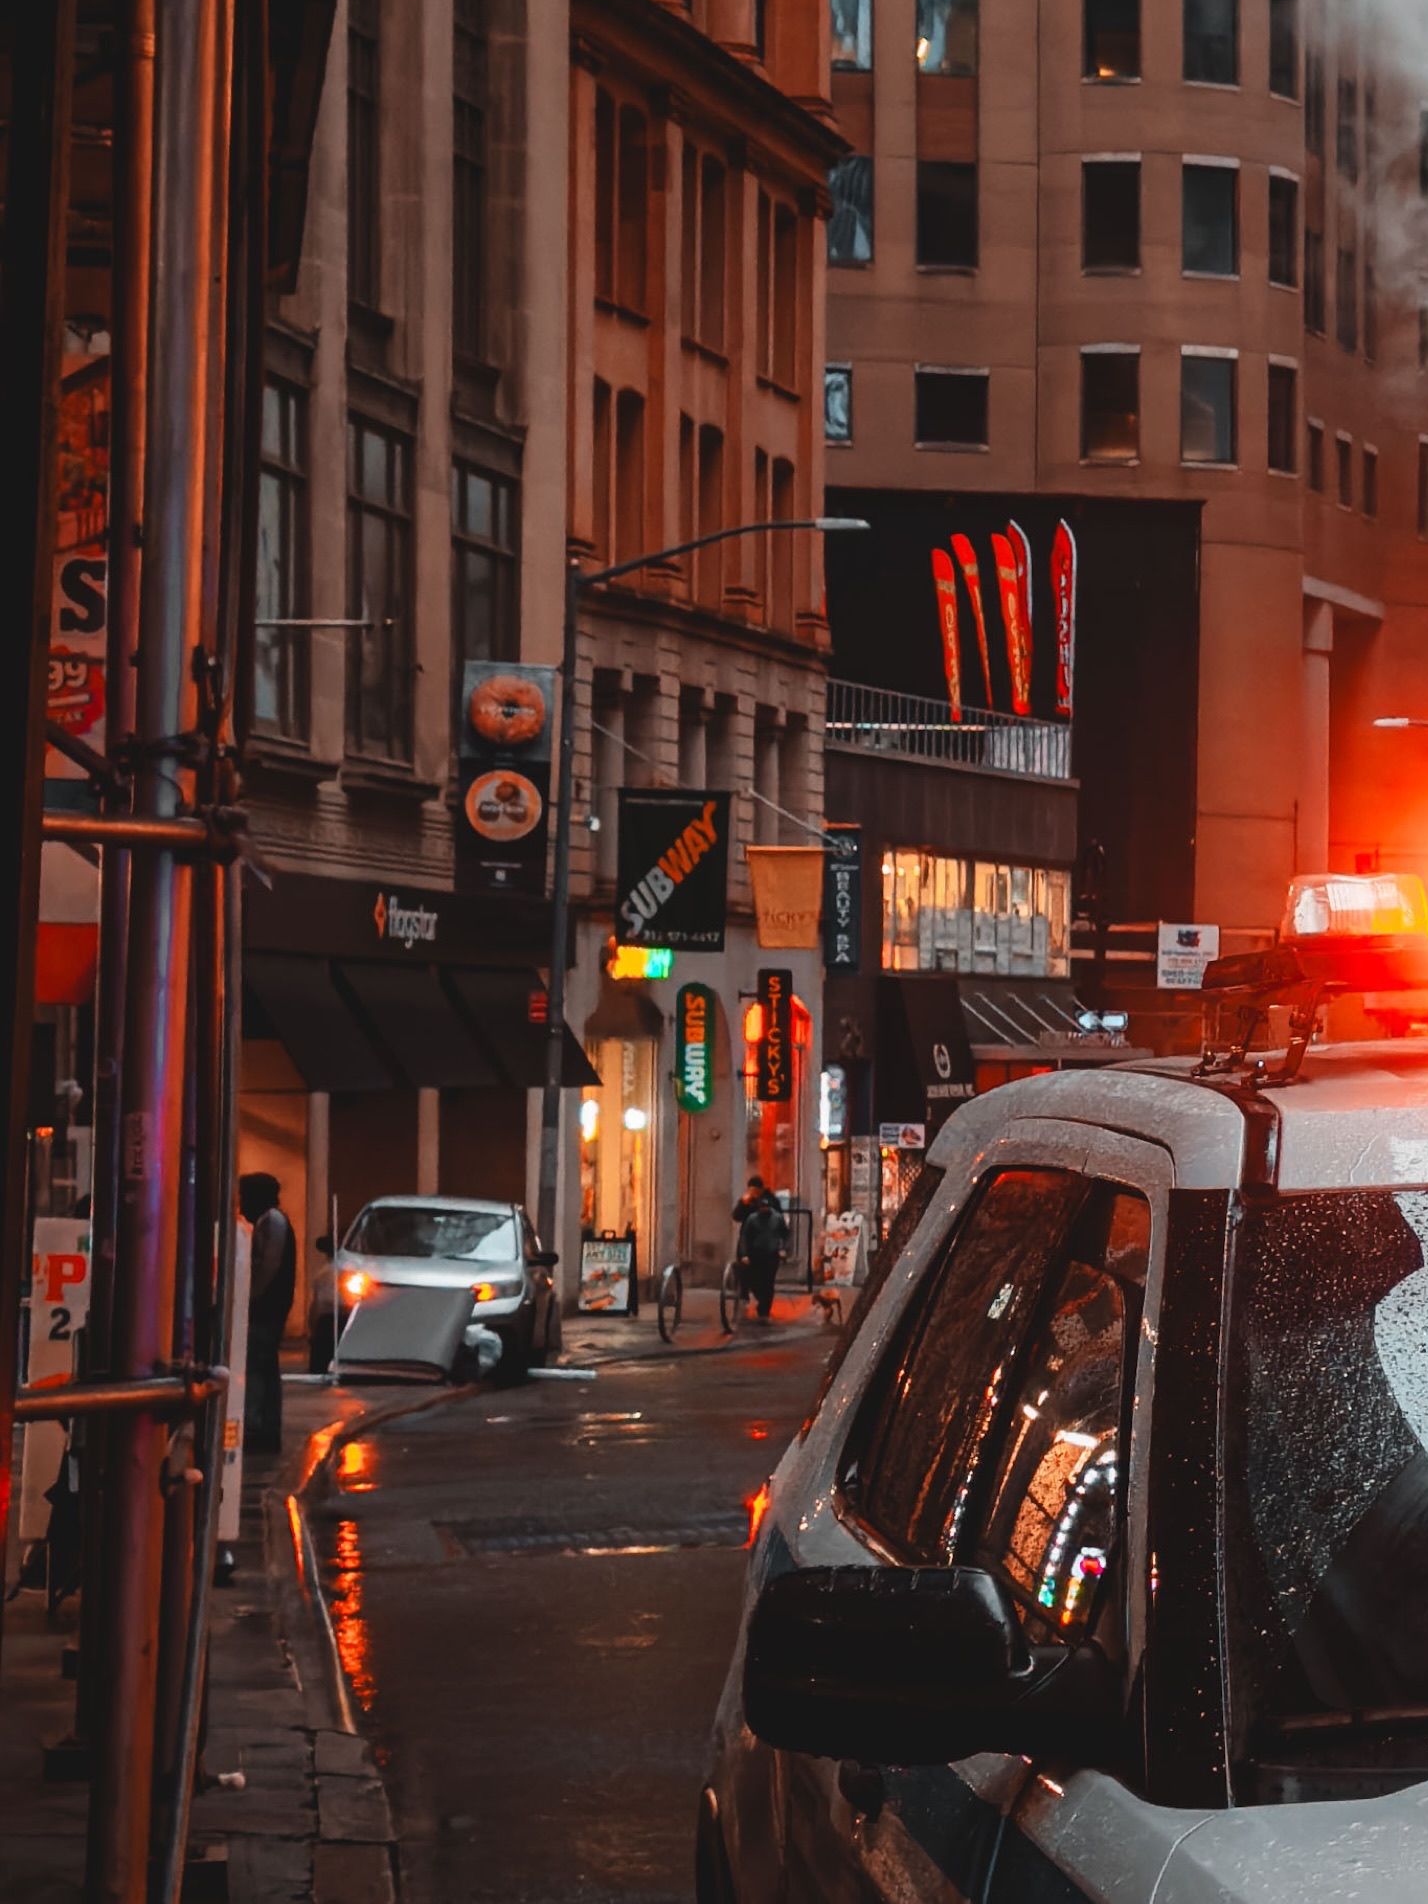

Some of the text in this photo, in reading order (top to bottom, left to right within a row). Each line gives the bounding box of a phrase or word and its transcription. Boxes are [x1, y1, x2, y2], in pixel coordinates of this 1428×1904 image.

[620, 799, 718, 938] SUBWAY
[683, 991, 707, 1106] SUBWAY
[767, 975, 786, 1095] STICKY'S
